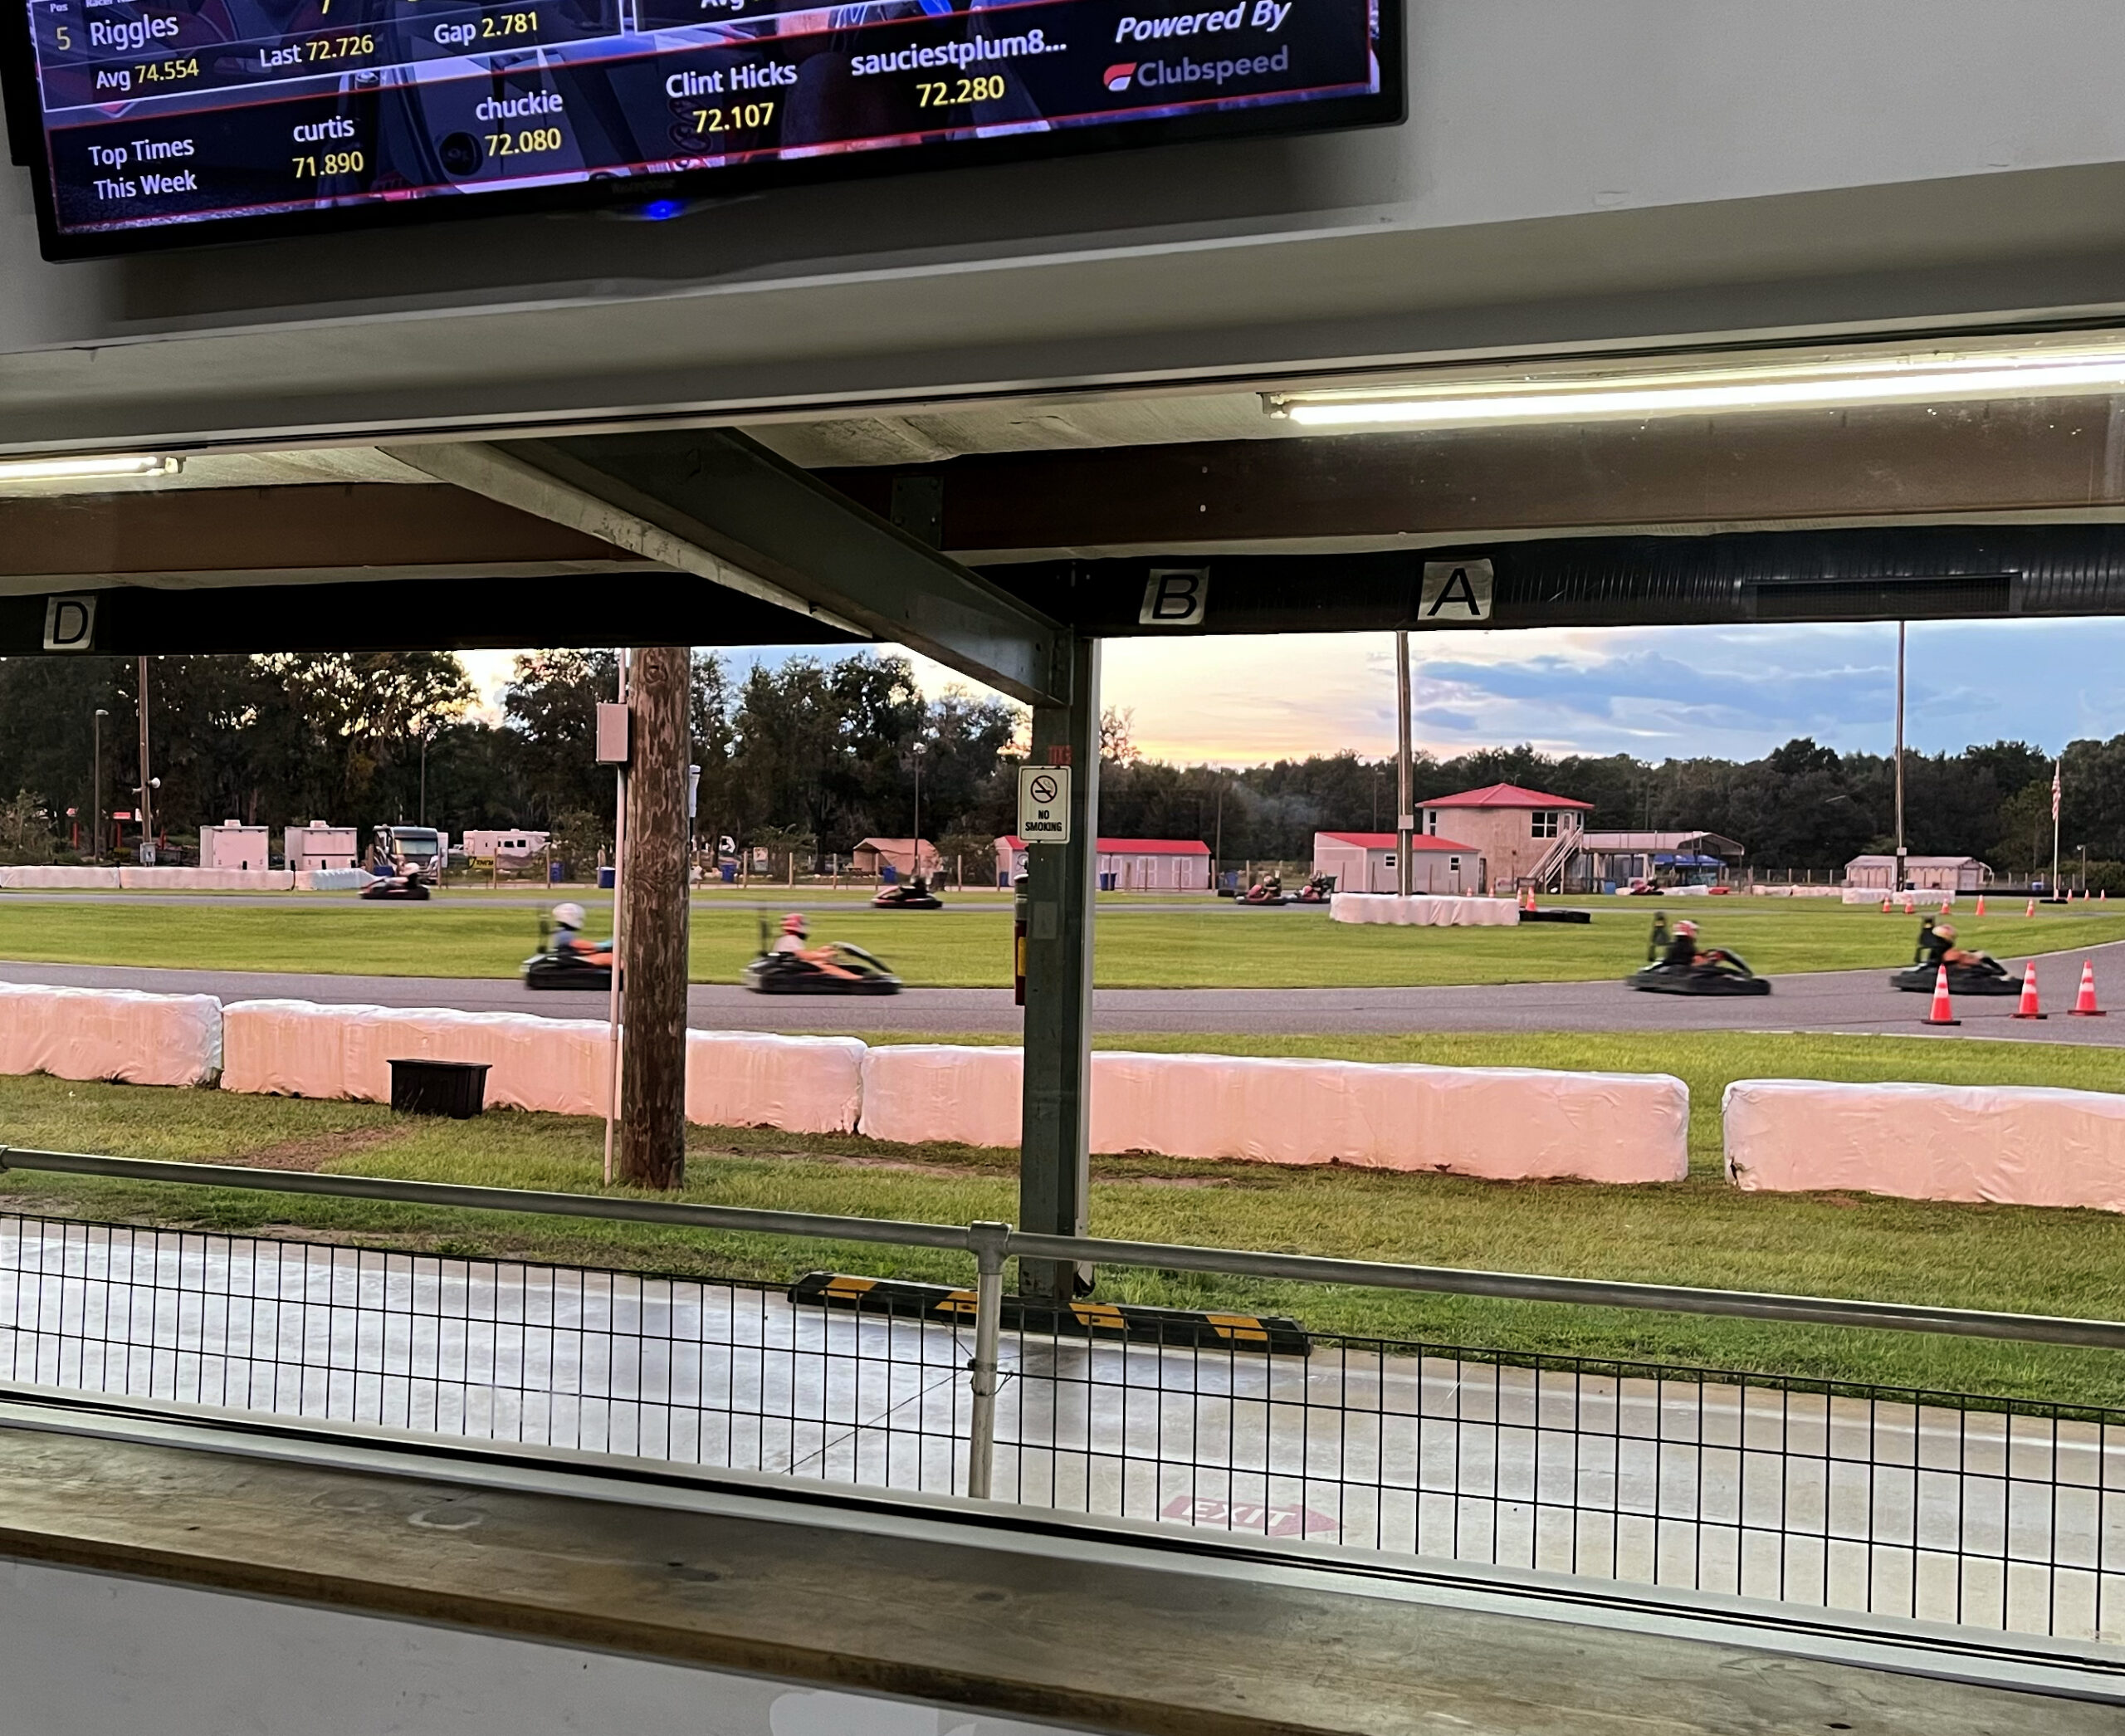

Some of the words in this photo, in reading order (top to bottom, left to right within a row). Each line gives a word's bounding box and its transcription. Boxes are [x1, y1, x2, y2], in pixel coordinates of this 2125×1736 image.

[50, 3, 68, 12] Pos
[1116, 1, 1246, 42] Powered
[1251, 0, 1292, 32] By
[56, 27, 71, 51] 5
[90, 13, 179, 51] Riggles
[433, 23, 476, 46] Gap
[481, 12, 538, 37] 2.781
[260, 44, 302, 67] Last
[305, 34, 374, 61] 72.726
[851, 29, 1067, 76] sauciestplum8...
[1137, 45, 1288, 86] Clubspeed
[96, 71, 131, 91] Avg
[134, 58, 199, 84] 74.554
[666, 72, 724, 98] Clint
[730, 61, 798, 90] Hicks
[476, 90, 563, 121] chuckie
[916, 76, 1004, 107] 72.280
[293, 115, 354, 142] curtis
[693, 103, 774, 134] 72.107
[88, 146, 127, 169] Top
[131, 139, 194, 161] Times
[485, 128, 562, 157] 72.080
[292, 151, 364, 178] 71.890
[94, 178, 136, 200] This
[140, 169, 198, 195] Week
[1152, 575, 1199, 619] B
[1427, 568, 1481, 616] A
[53, 601, 89, 644] D
[1025, 821, 1062, 831] SMOKING
[1038, 809, 1050, 820] NO
[1181, 1501, 1295, 1527] EXIT
